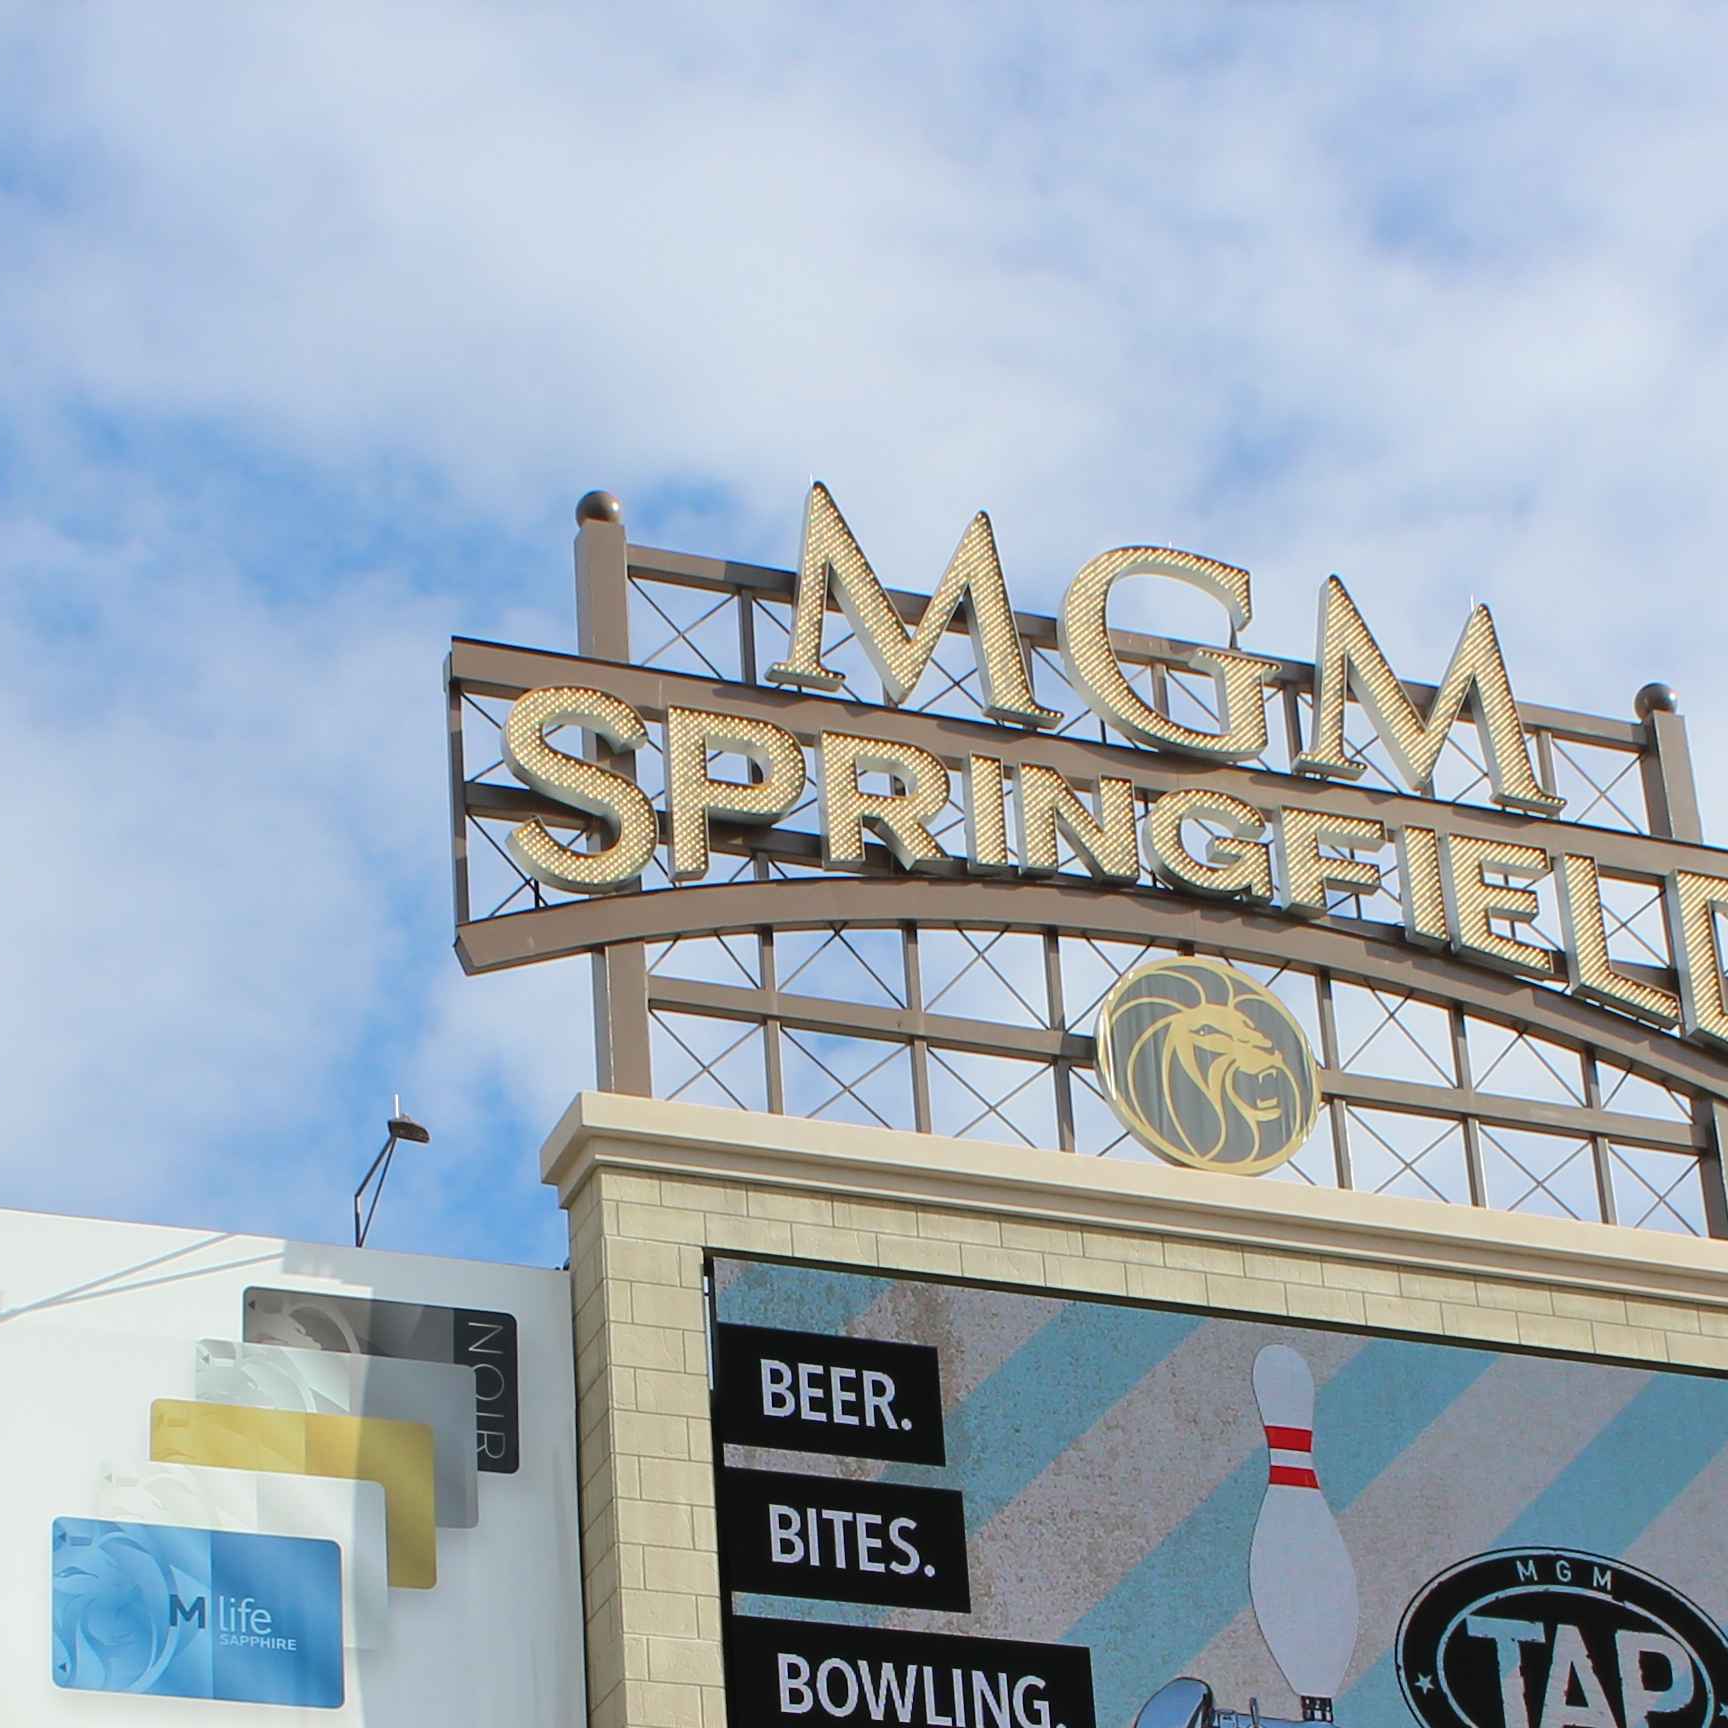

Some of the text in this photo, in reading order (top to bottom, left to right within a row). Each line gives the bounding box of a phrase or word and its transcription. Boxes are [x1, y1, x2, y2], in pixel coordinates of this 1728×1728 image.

[765, 481, 1566, 818] MGM
[468, 1321, 505, 1459] NOIR
[760, 1358, 913, 1432] BEER.
[768, 1503, 936, 1578] BITES.
[1516, 1560, 1613, 1591] MGM
[219, 1633, 297, 1651] SAPPHIRE
